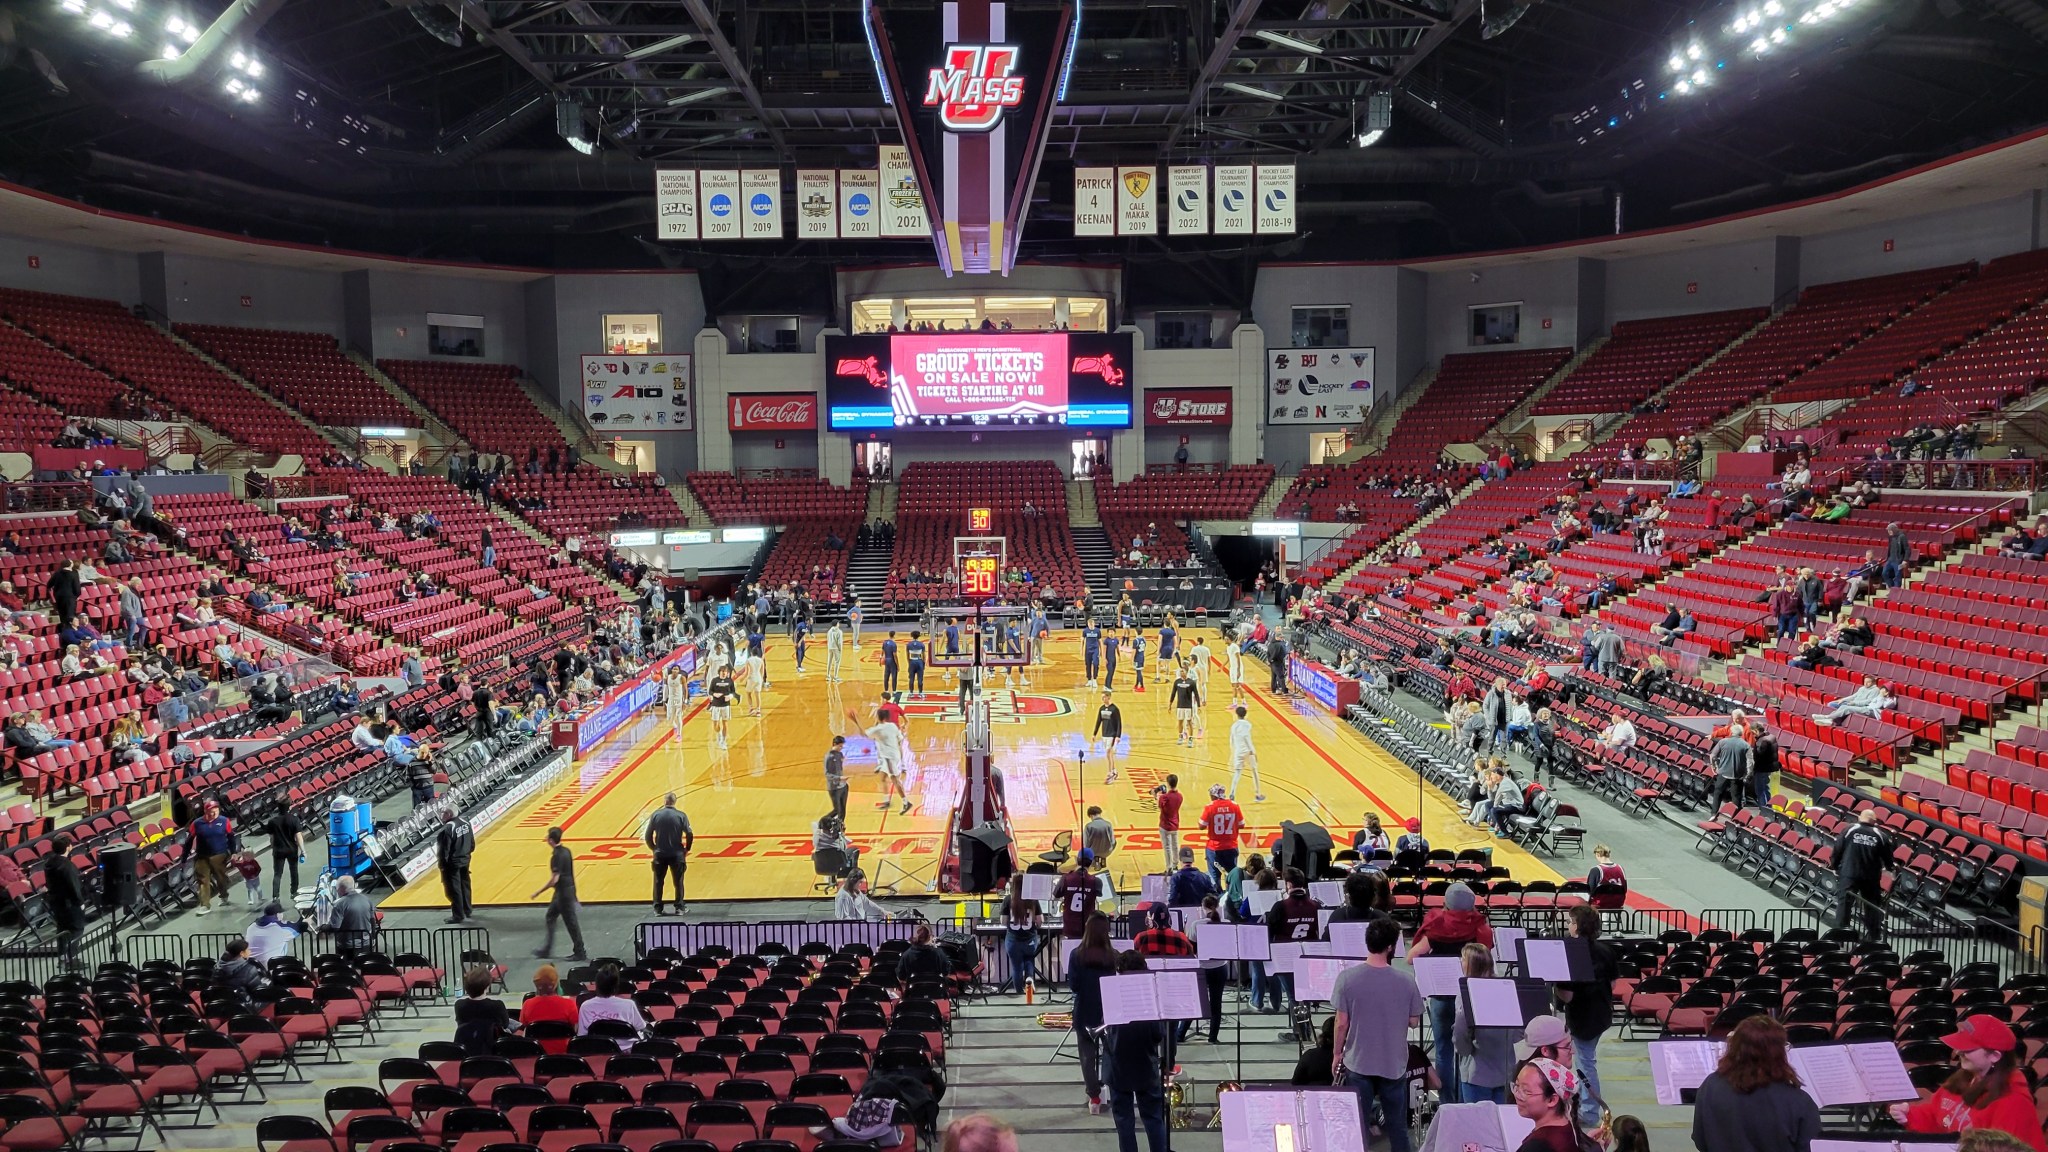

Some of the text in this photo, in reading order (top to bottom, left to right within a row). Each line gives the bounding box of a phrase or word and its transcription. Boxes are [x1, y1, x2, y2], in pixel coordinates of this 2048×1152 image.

[1077, 179, 1112, 189] PATRICK
[1090, 194, 1097, 208] 4
[662, 203, 692, 216] ECAC
[1125, 211, 1150, 219] MAKAR
[897, 216, 921, 228] 2021
[1077, 214, 1112, 224] KEENAN
[1178, 219, 1199, 228] 2022
[1224, 218, 1243, 228] 2021
[1261, 218, 1292, 227] 2018-19
[668, 223, 687, 232] 1972
[711, 223, 731, 232] 2007
[753, 223, 772, 232] 2019
[808, 223, 827, 232] 2019
[851, 223, 870, 232] 2021
[1129, 222, 1146, 230] 2019
[916, 352, 1044, 373] GROUP TICKETS
[924, 371, 1037, 384] ON SALE NOW!
[589, 380, 606, 388] VCU
[916, 385, 958, 397] TICKETS
[961, 385, 1008, 396] STARTING
[1011, 385, 1024, 396] AT
[746, 401, 812, 423] Coca-Cola
[1316, 405, 1327, 418] N
[971, 414, 990, 422] 19:38
[973, 516, 987, 528] 30
[966, 559, 995, 571] 19:38
[967, 572, 990, 592] 30
[1214, 813, 1235, 835] 87
[1070, 893, 1086, 912] 6
[1291, 924, 1310, 939] 6
